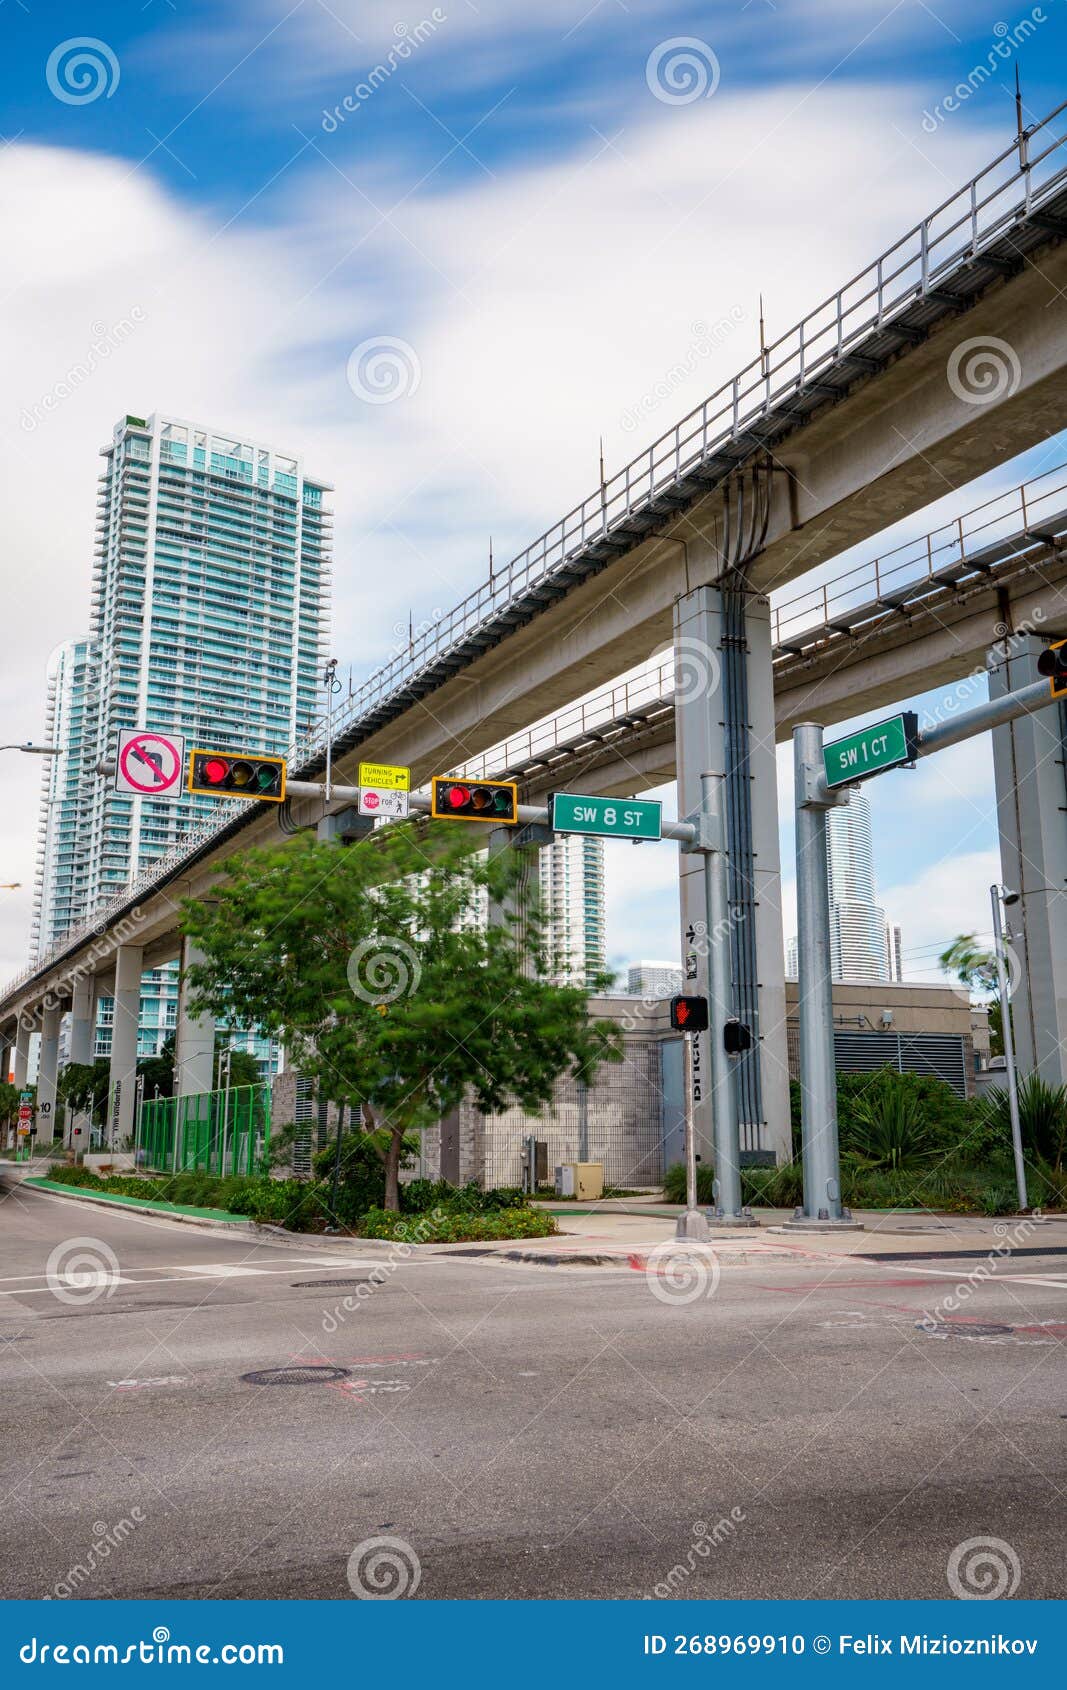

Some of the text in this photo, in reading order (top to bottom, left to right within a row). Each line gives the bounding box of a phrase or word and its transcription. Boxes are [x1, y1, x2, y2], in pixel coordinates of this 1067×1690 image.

[840, 735, 887, 769] SW 1 CT
[364, 767, 393, 777] TURNING
[363, 776, 394, 785] VEHICLES
[364, 797, 393, 806] STOP FOR
[573, 806, 644, 827] SW 8 ST
[40, 1102, 51, 1113] 10
